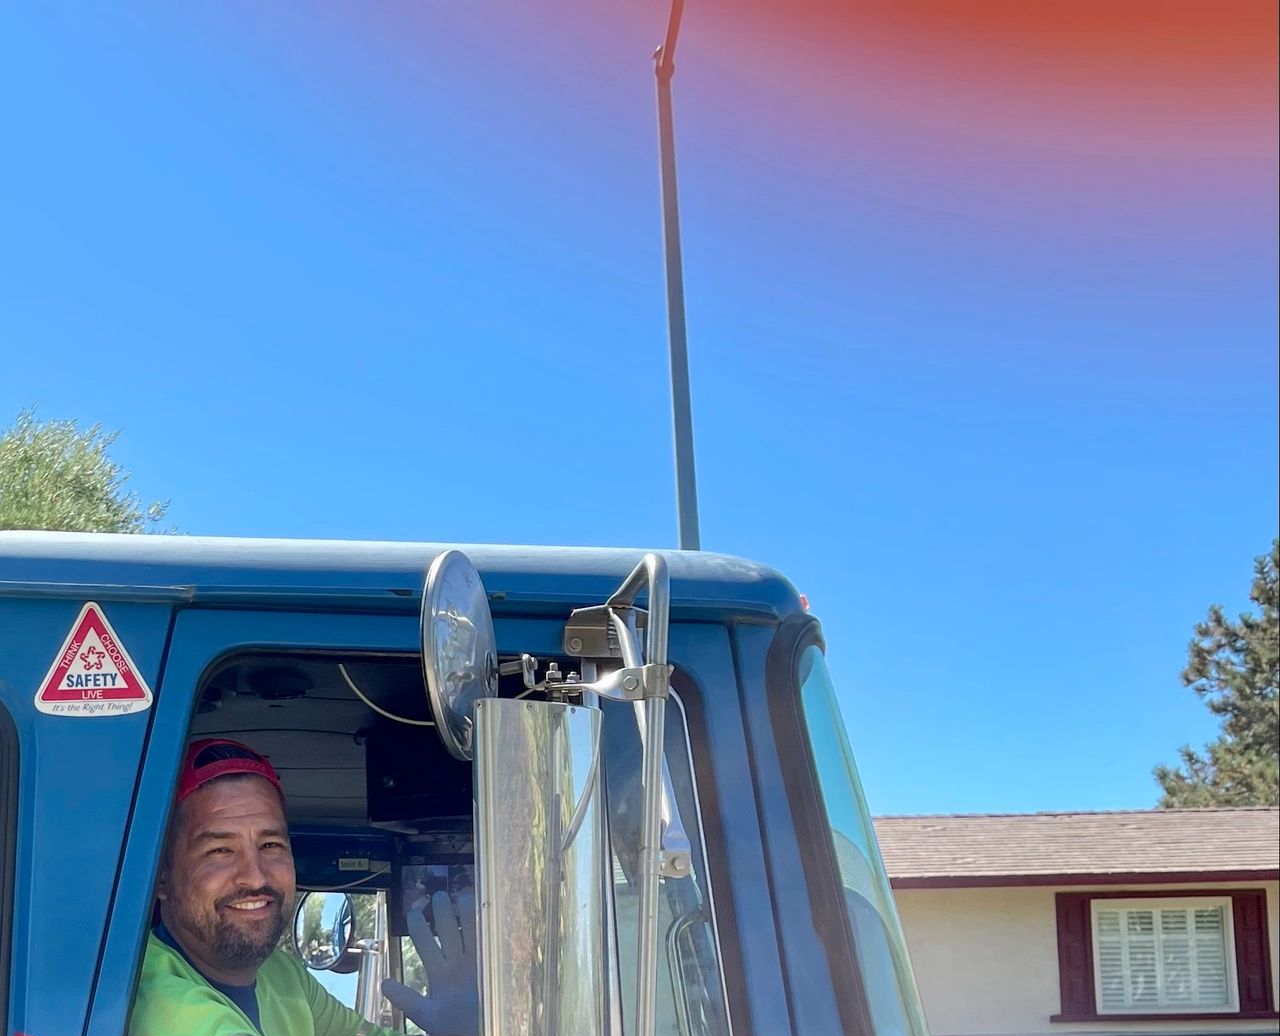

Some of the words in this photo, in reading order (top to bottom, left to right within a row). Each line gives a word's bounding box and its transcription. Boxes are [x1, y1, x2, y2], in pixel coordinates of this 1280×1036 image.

[60, 640, 81, 669] THINK
[100, 633, 129, 674] CHOOSE
[66, 673, 117, 688] SAFETY
[82, 690, 103, 699] LIVE
[53, 704, 64, 712] It's
[67, 703, 79, 712] the
[82, 703, 104, 713] Right
[107, 702, 133, 713] Thing!
